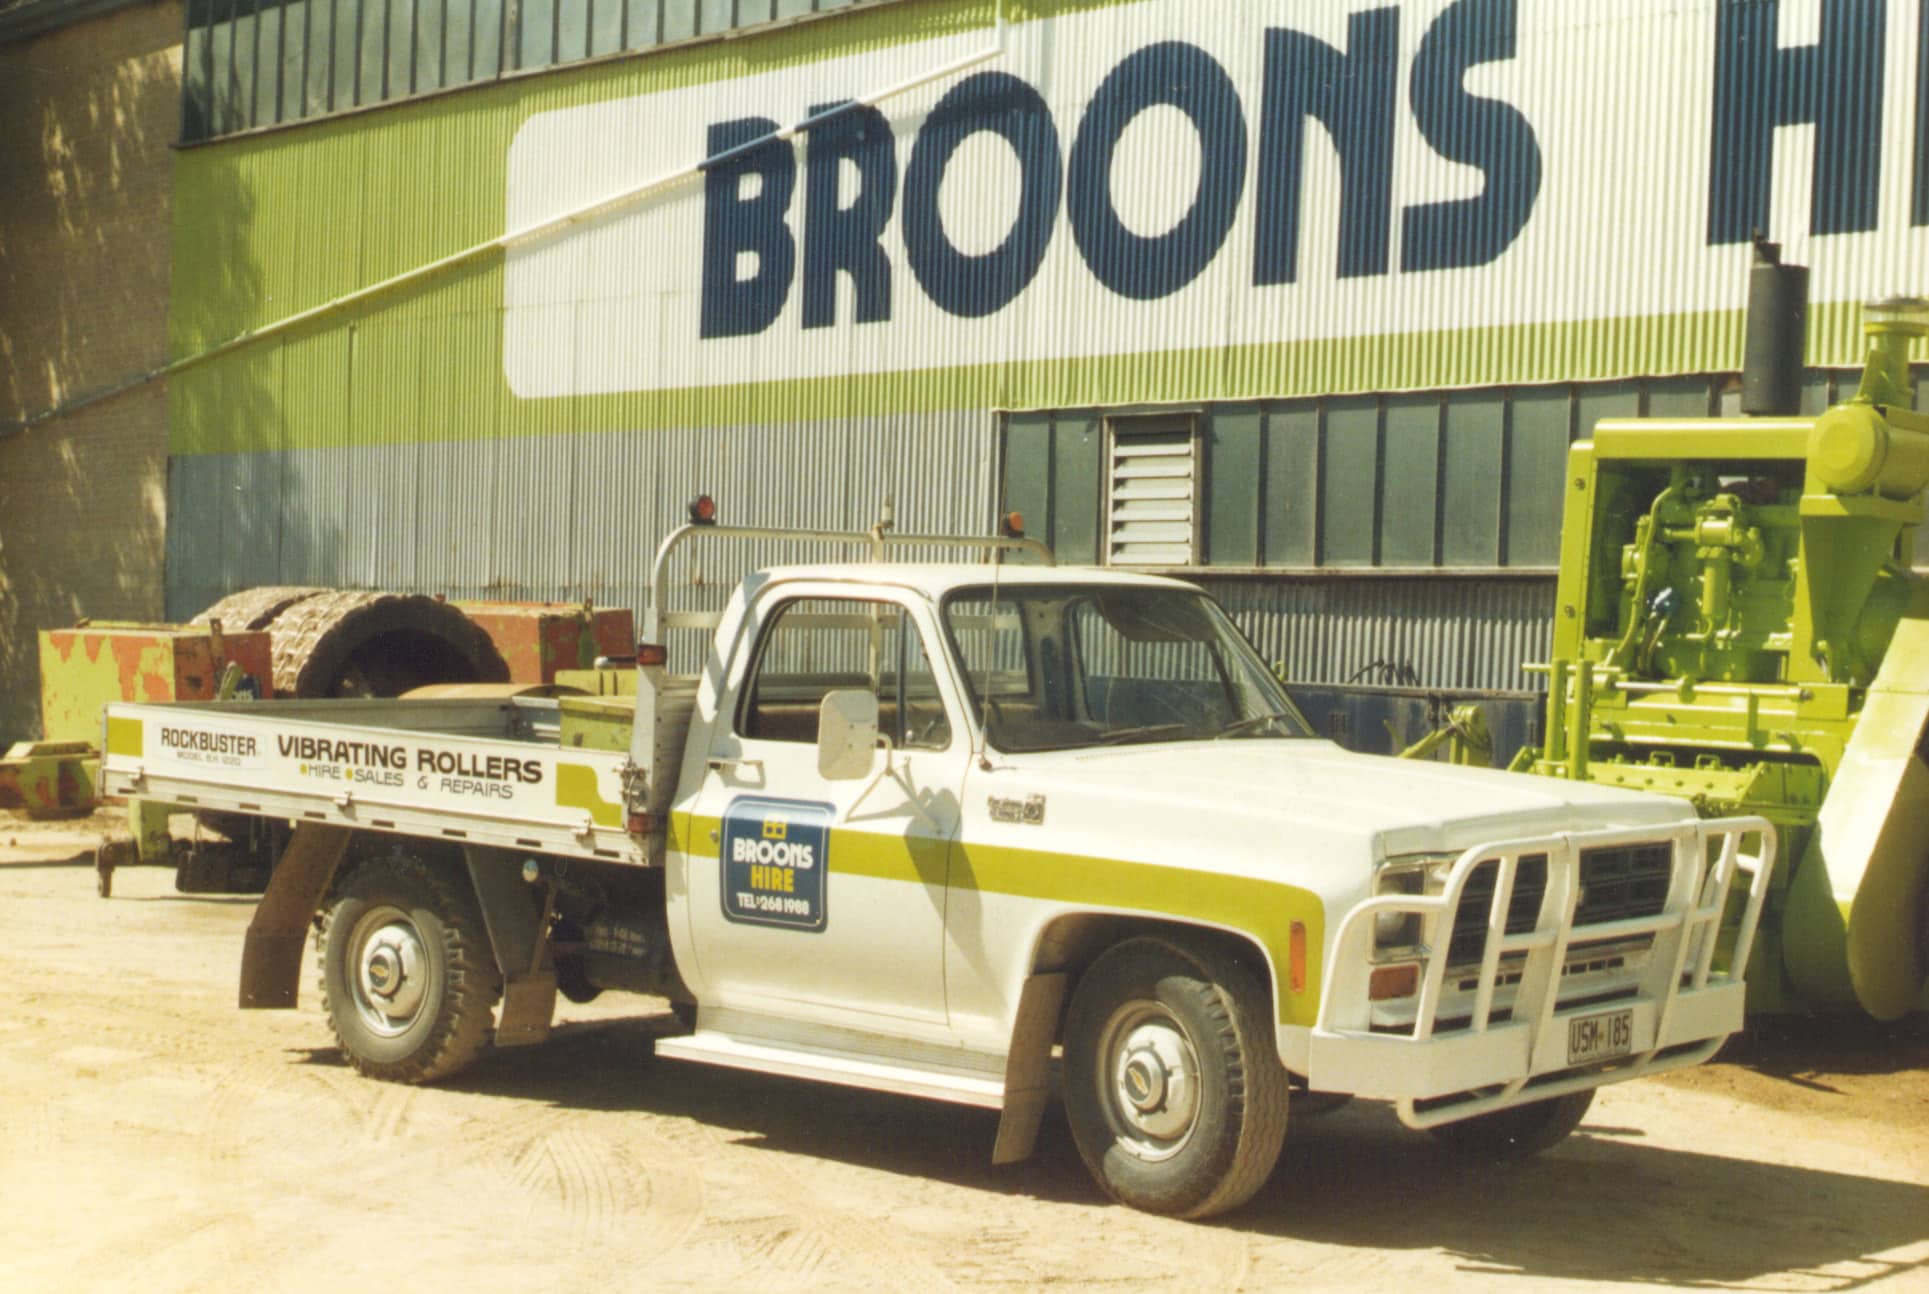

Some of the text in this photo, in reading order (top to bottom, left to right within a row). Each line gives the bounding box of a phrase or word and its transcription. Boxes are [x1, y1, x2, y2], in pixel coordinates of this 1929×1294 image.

[700, 0, 1543, 340] BROONS
[161, 727, 257, 757] ROCKBUSTER
[277, 734, 543, 784] VIBRATING ROLLERS
[308, 763, 513, 800] HIRE SALES & REPAIRS
[733, 837, 814, 869] BROONS
[751, 865, 794, 893] HIRE
[1572, 1014, 1629, 1054] USM 185
